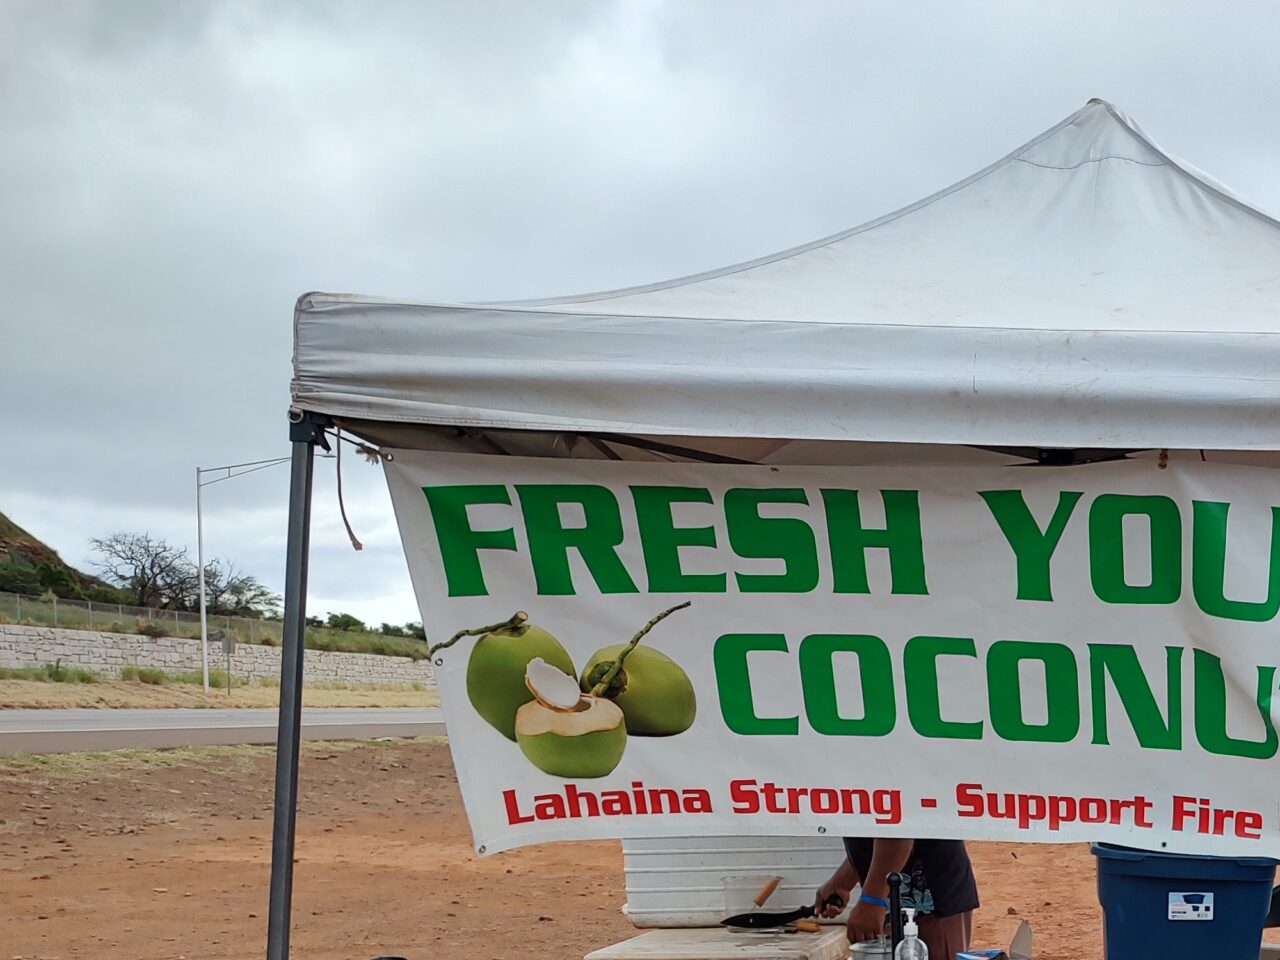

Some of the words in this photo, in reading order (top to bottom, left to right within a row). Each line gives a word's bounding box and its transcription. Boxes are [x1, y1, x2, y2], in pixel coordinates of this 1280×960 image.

[422, 484, 930, 598] FRESH
[502, 781, 713, 826] Lahaina
[729, 779, 902, 825] Strong
[956, 783, 1153, 830] Support
[1171, 796, 1264, 840] Fire
